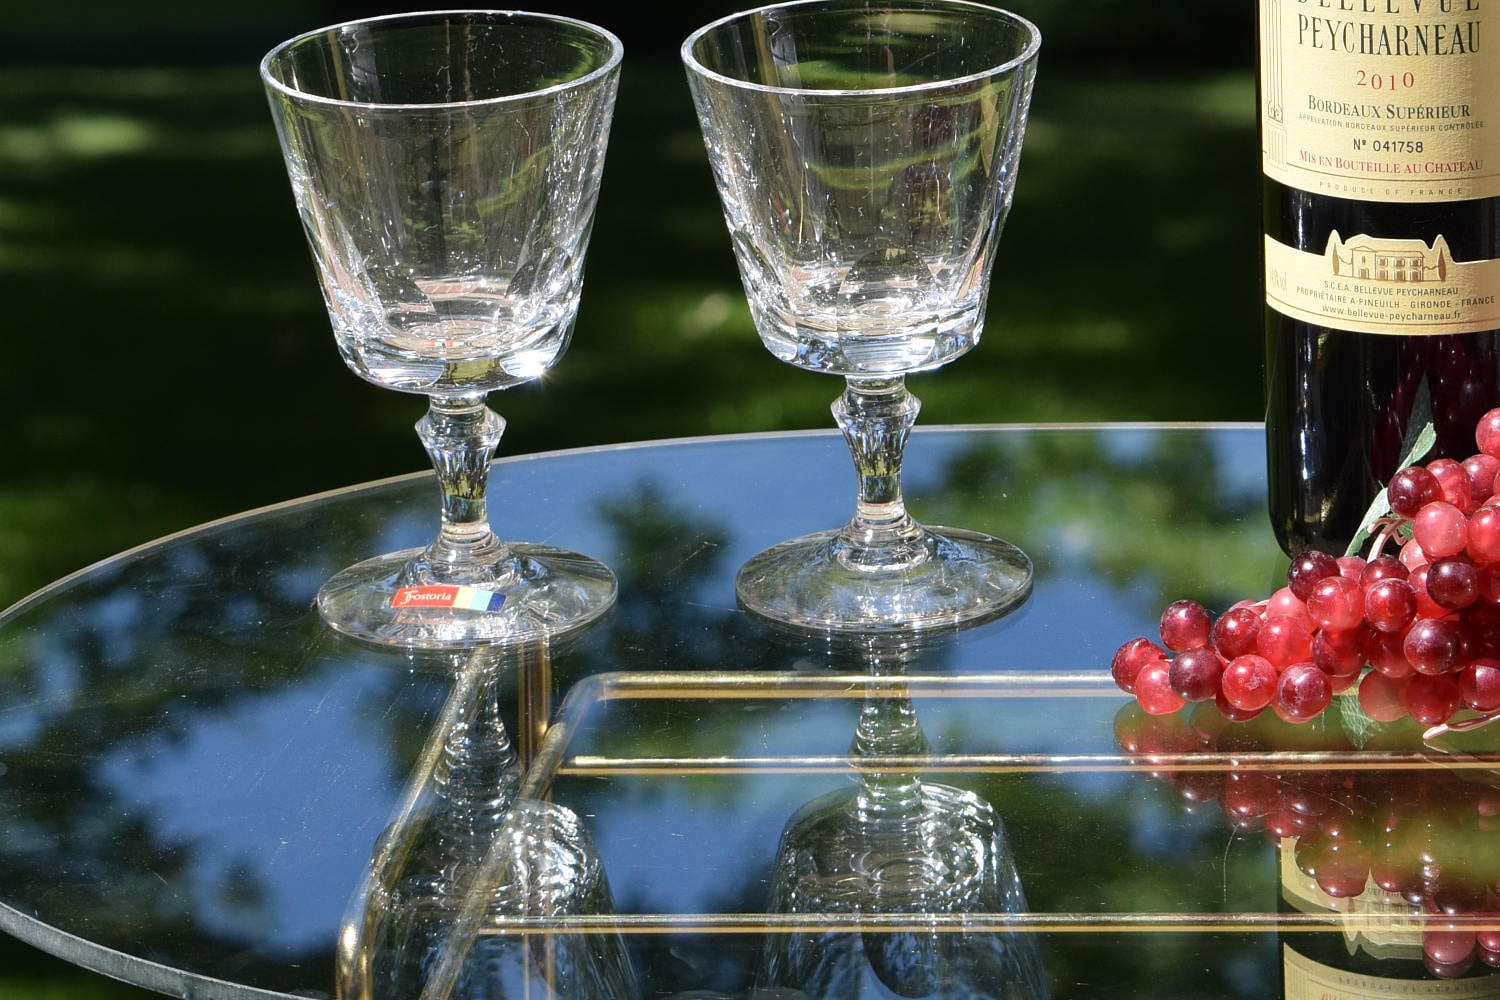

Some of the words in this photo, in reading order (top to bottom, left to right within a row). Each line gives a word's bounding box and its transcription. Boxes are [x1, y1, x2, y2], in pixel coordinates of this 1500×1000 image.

[1298, 14, 1482, 57] PEYCHARNEAU
[1356, 70, 1415, 91] 2010
[1308, 95, 1380, 119] BORDEAUX
[1386, 103, 1470, 120] SUPÉRIEUR
[1298, 113, 1343, 128] APPELLATION
[1346, 122, 1386, 131] BORDEAUX
[1373, 140, 1424, 153] 041758
[1299, 149, 1316, 163] MIS
[1319, 156, 1332, 168] EN
[1335, 157, 1400, 174] BOUTEILLE
[1404, 163, 1421, 174] AU
[1424, 159, 1484, 174] CHATEAU
[1385, 187, 1400, 196] OF
[1410, 187, 1464, 196] FRANCE
[1296, 285, 1347, 304] PROPRIÉTAIRE
[1350, 296, 1356, 304] A
[1359, 298, 1400, 309] PINEUILH
[1410, 299, 1452, 309] GIRONDE
[1461, 296, 1495, 307] FRANCE
[1354, 285, 1393, 296] BELLEVUE
[1396, 286, 1459, 297] PEYCHARNEAU
[1322, 304, 1461, 321] www.bellevue-peycharneau.fr
[400, 590, 452, 604] Fostoria
